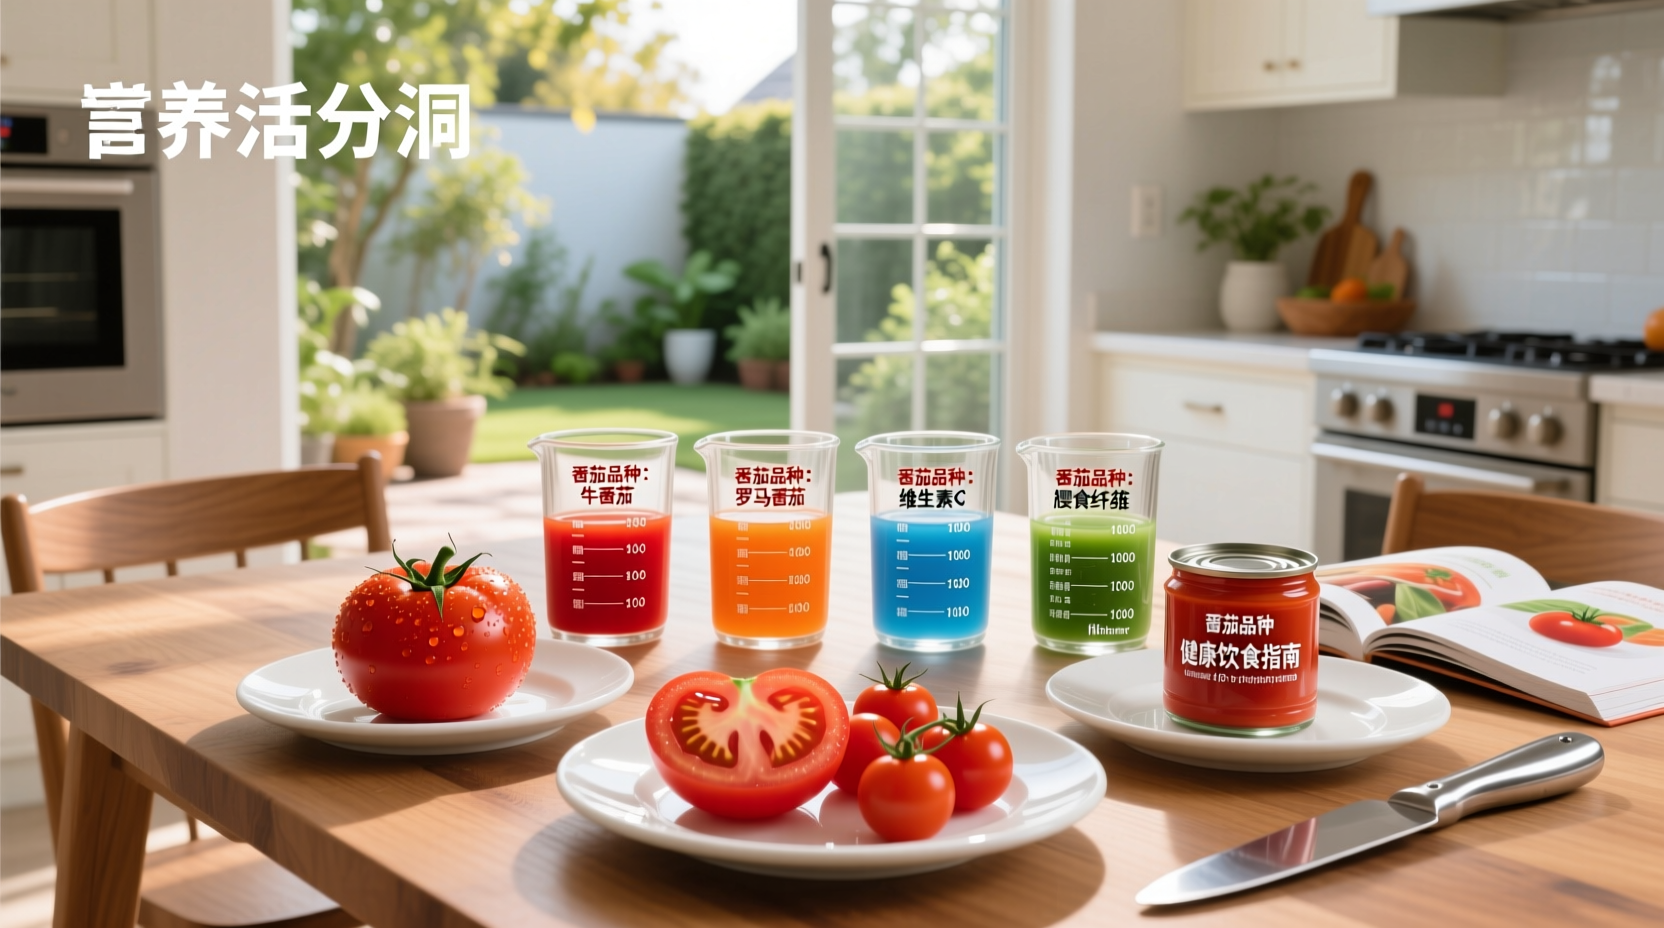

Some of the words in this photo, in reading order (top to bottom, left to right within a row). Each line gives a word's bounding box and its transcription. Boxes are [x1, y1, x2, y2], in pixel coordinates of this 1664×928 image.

[580, 485, 635, 505] 牛番茄
[735, 487, 806, 507] 罗马番茄
[899, 488, 967, 509] 维生素C
[626, 543, 647, 554] 100
[947, 549, 971, 561] 1000
[1110, 552, 1136, 563] 1000
[626, 570, 647, 581] 100
[1110, 580, 1135, 592] 1000
[626, 597, 646, 608] 100
[1110, 608, 1135, 620] 1000
[1180, 638, 1302, 670] 健康饮食指南
